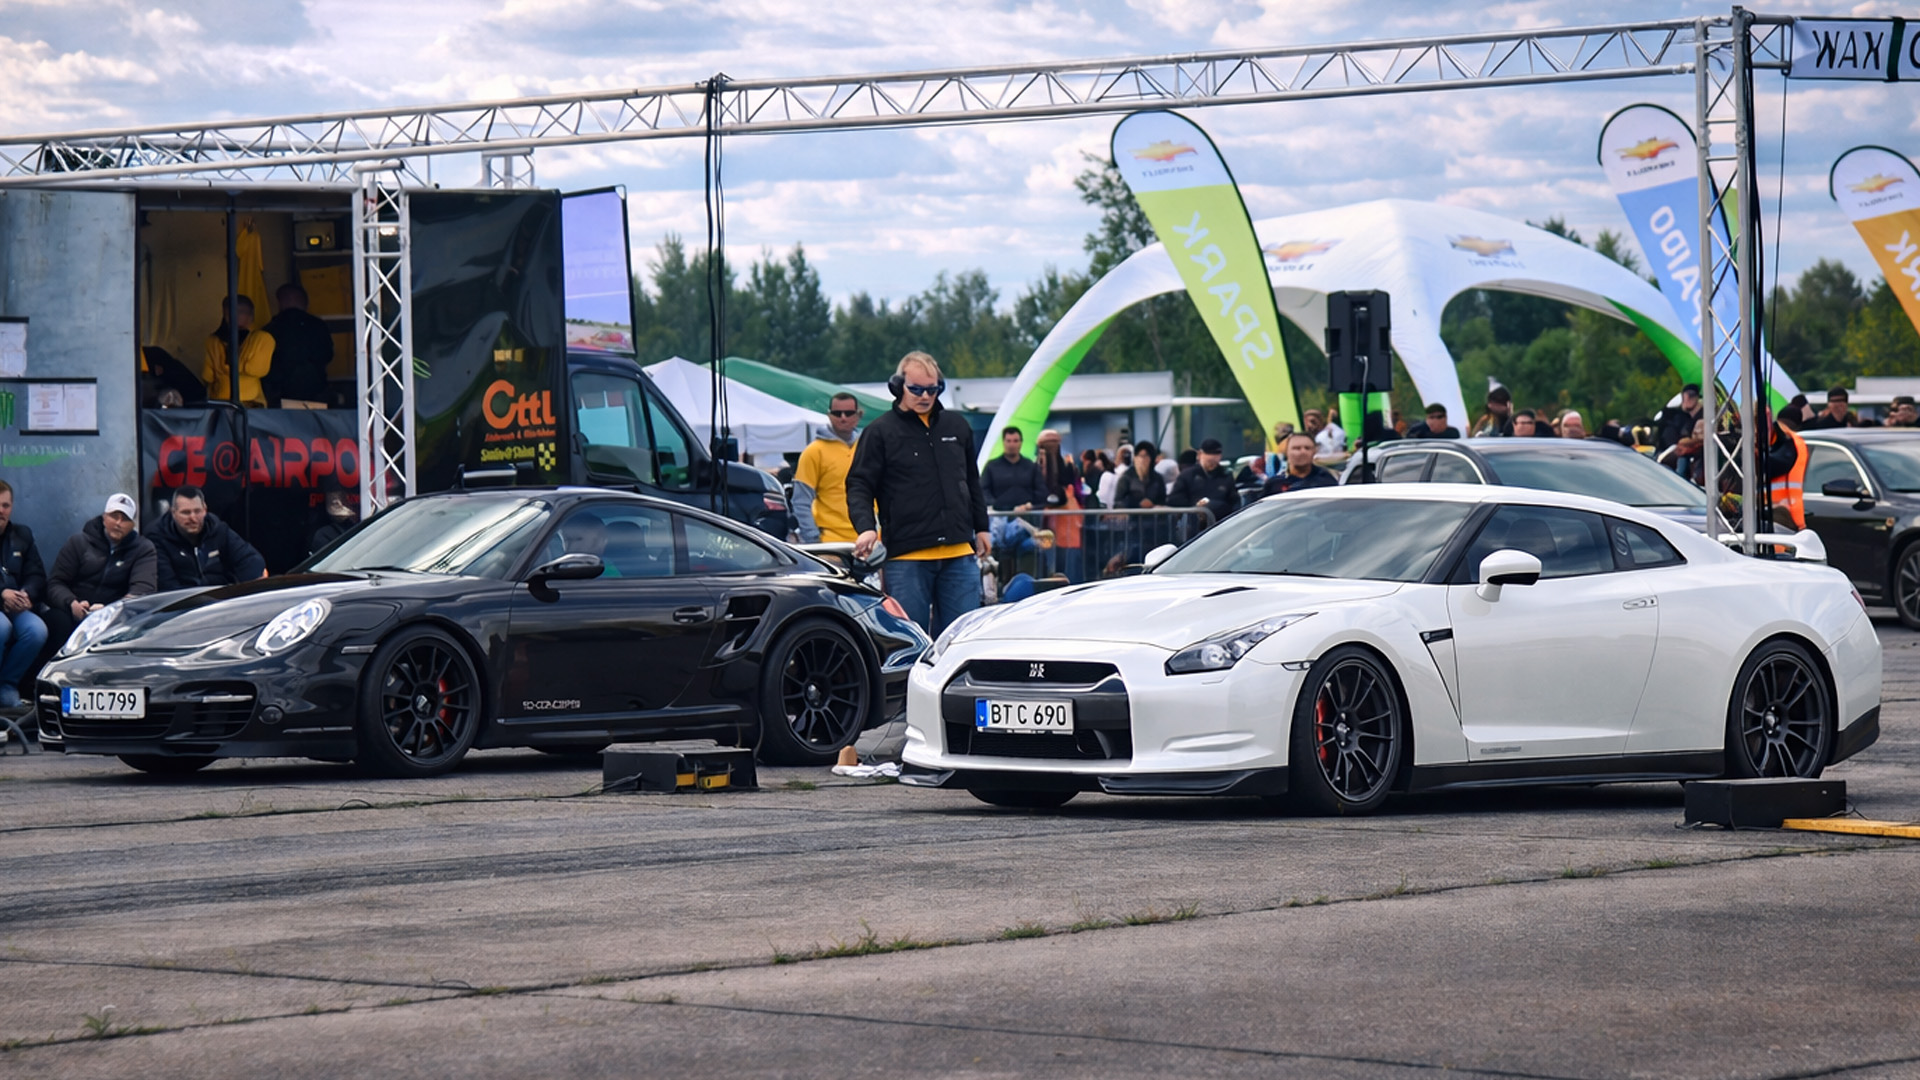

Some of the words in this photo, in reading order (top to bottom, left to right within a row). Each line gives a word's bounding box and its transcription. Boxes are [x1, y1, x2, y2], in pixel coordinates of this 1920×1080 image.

[1811, 30, 1884, 70] WAX
[153, 434, 207, 488] CE
[242, 435, 395, 489] AIRPO
[1033, 704, 1066, 726] 690
